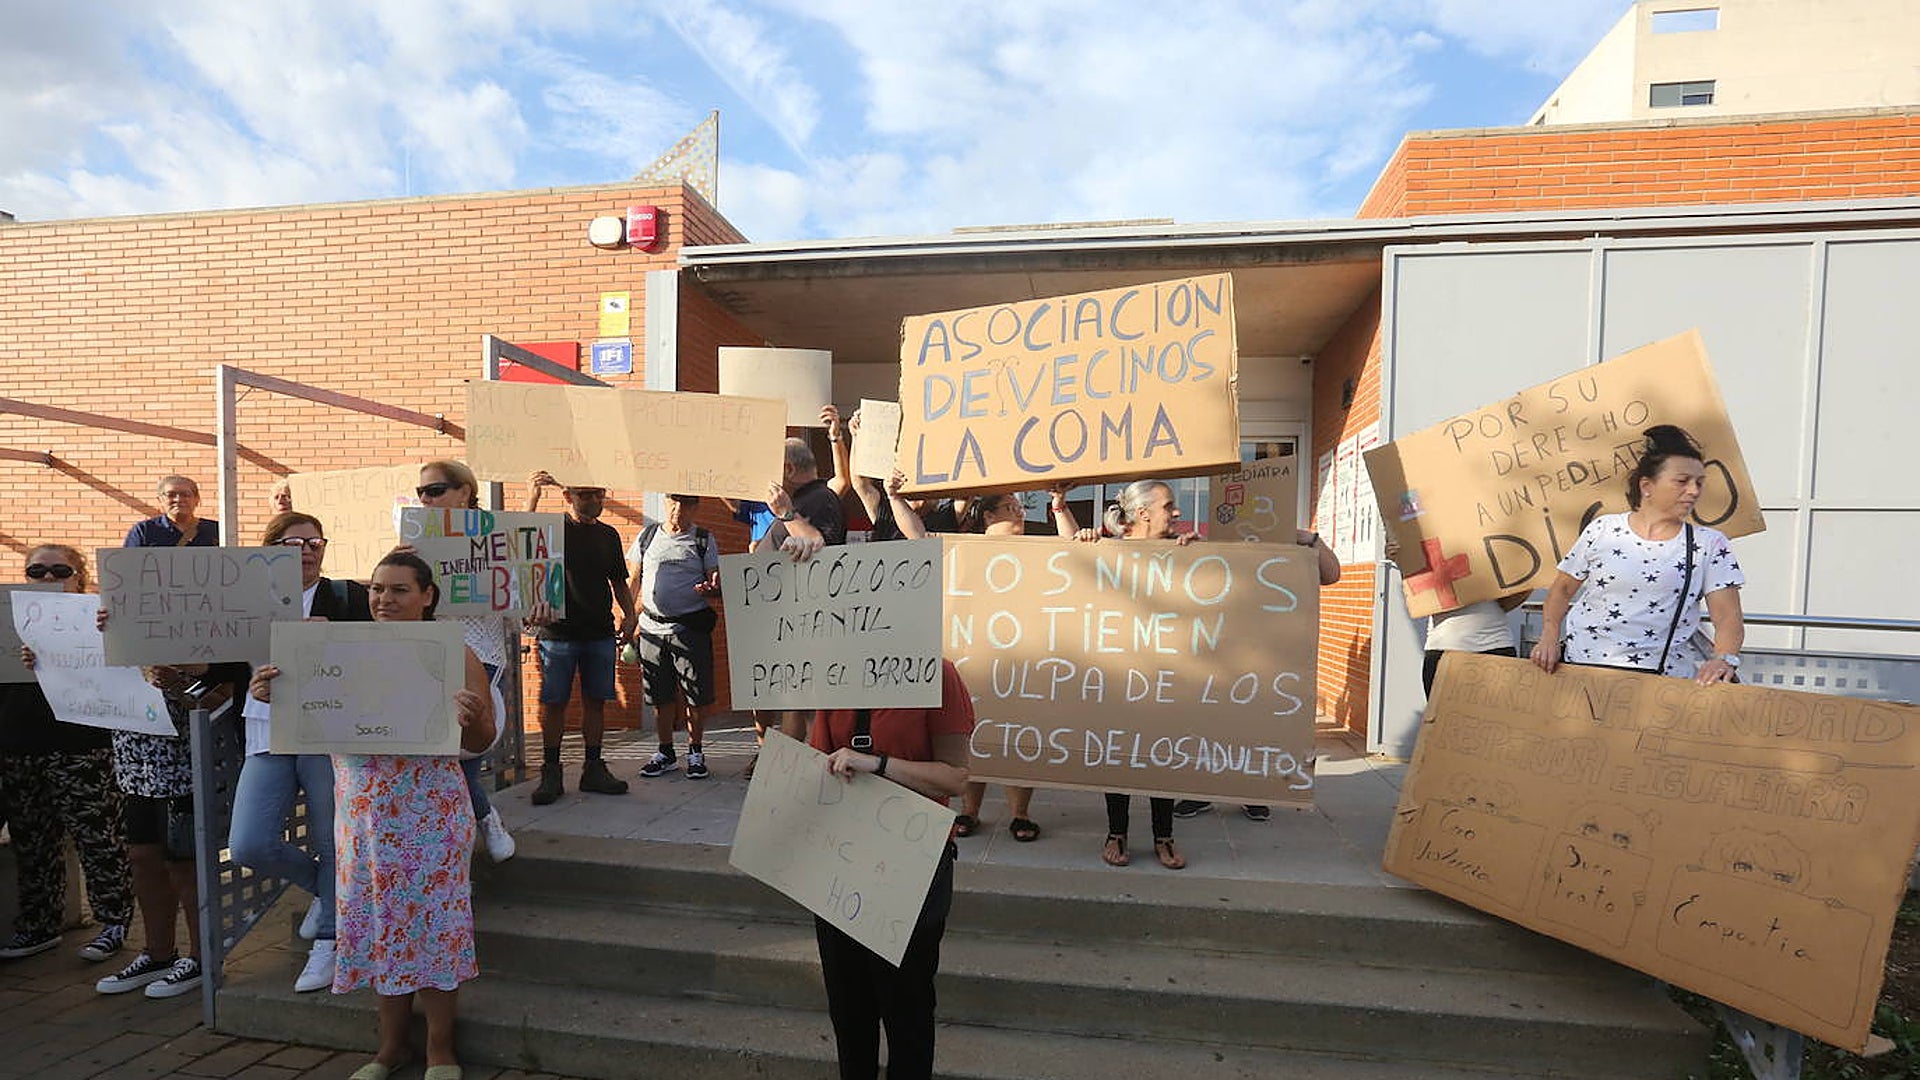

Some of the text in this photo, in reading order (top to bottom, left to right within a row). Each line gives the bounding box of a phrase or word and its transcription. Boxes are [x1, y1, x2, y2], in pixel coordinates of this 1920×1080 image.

[918, 278, 1223, 366] ASOCIACIÓN
[924, 329, 1216, 422] DE VECINOS
[1443, 377, 1599, 452] POR SU
[1490, 400, 1648, 476] DERECHO
[916, 427, 987, 485] LA
[1013, 402, 1183, 473] COMA
[1220, 465, 1290, 483] PEDIATRA
[1476, 438, 1647, 526] A UN PEDIAT
[334, 511, 391, 533] ALUD
[403, 508, 495, 538] SALUD
[470, 525, 562, 566] MENTAL
[103, 550, 241, 591] SALUD
[451, 561, 563, 611] EL BARRIO
[743, 552, 931, 605] PSICÓLOGO
[948, 546, 1297, 612] LOS NIÑOS
[111, 592, 247, 616] MENTAL
[777, 606, 891, 641] INFANTIL
[189, 645, 215, 657] YA
[949, 610, 1022, 649] NO
[752, 656, 936, 697] PARA EL BARRIO
[1127, 669, 1174, 702] DE
[1201, 672, 1302, 716] LOS
[1551, 673, 1643, 730] UNA
[1648, 683, 1906, 745] SANIDAD
[970, 719, 1313, 790] CTOS DE LOS ADULTOS
